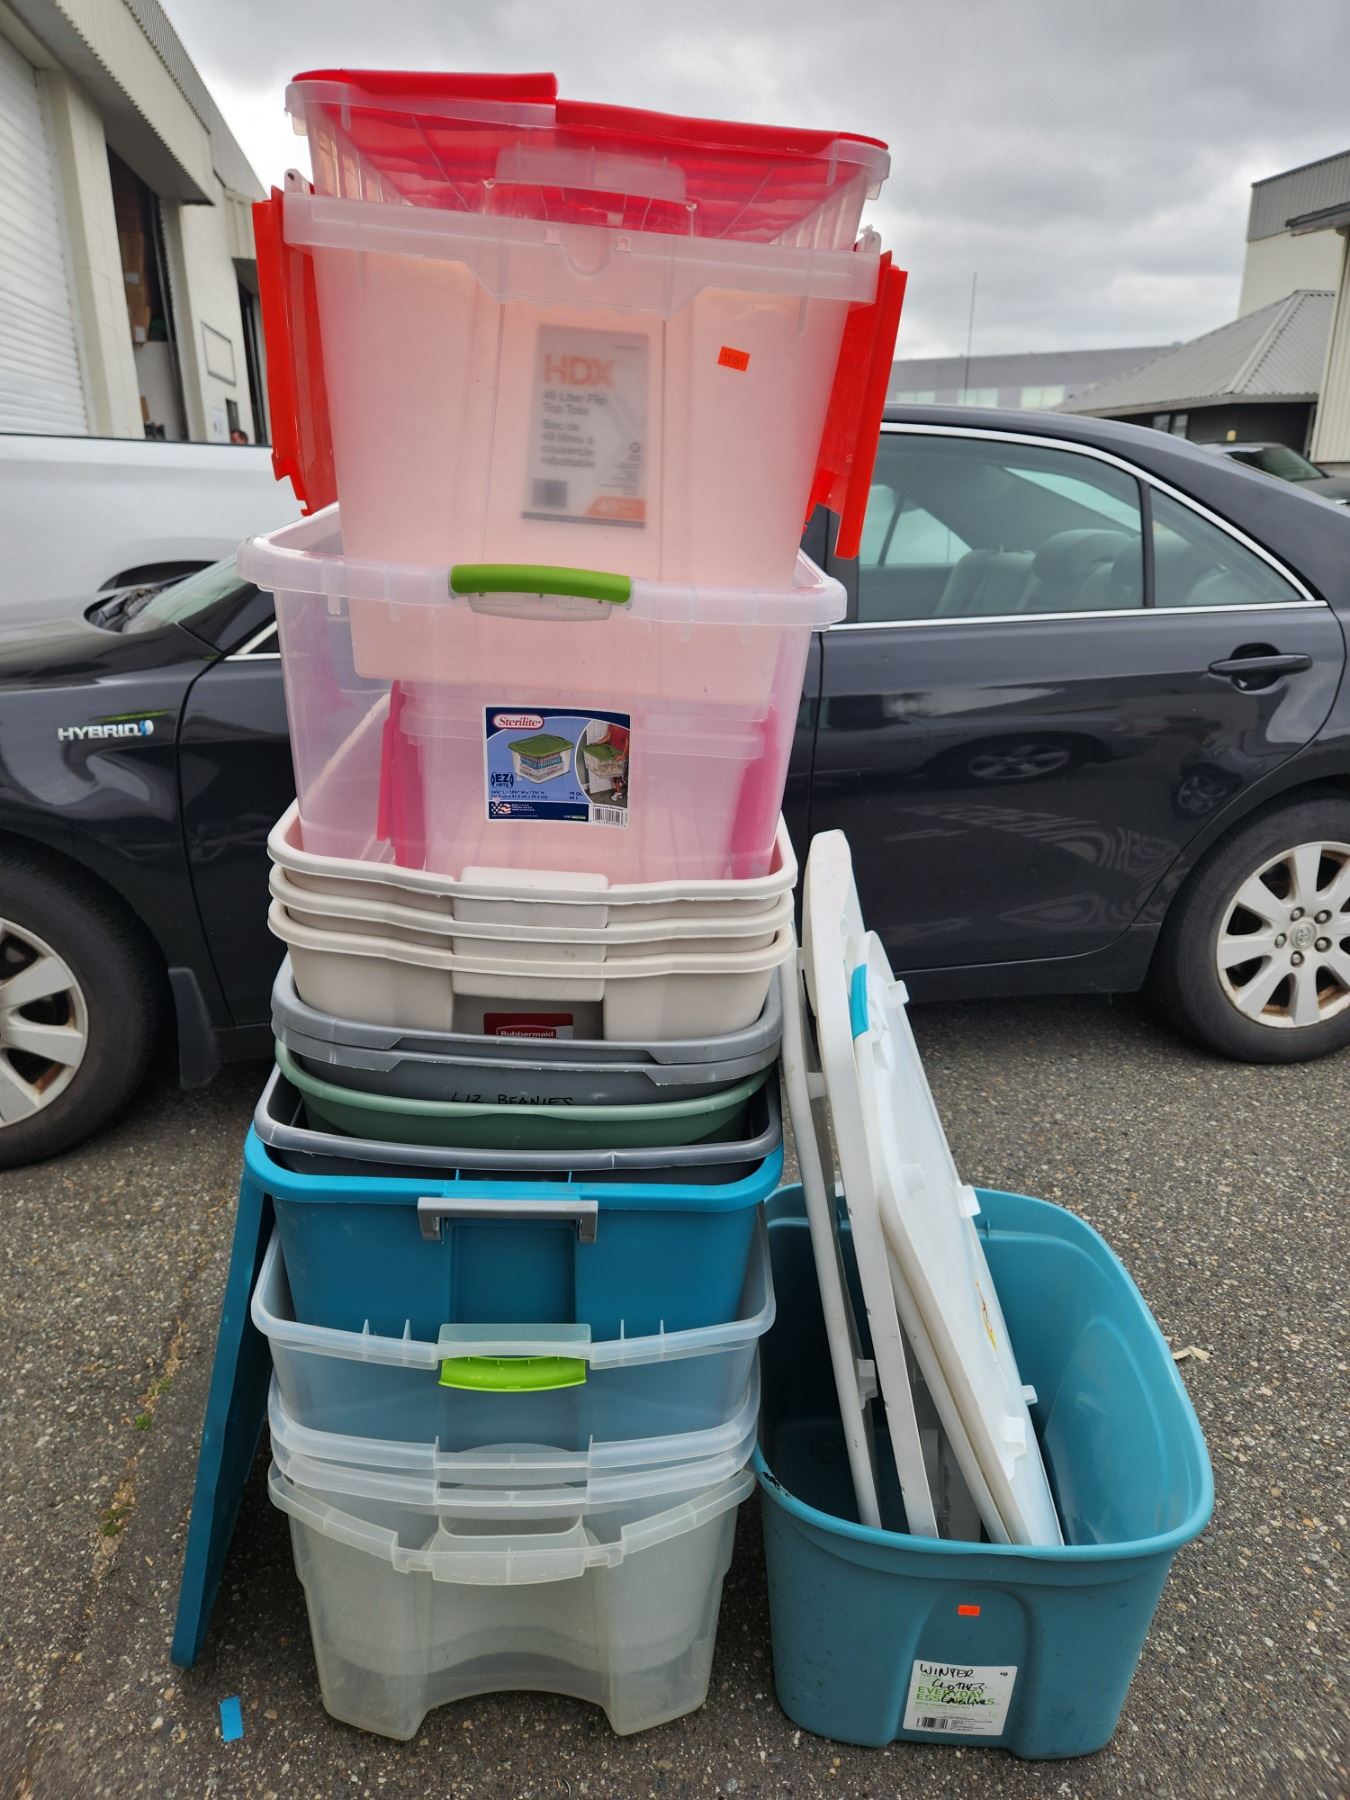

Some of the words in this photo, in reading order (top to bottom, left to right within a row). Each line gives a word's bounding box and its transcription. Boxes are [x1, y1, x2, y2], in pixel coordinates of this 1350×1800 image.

[543, 353, 616, 388] HDX
[499, 716, 536, 727] Sterilite
[57, 722, 142, 741] HYBRID
[495, 773, 510, 783] EZ
[500, 1030, 554, 1038] Rubbermaid
[451, 1091, 483, 1103] LIZ
[497, 1093, 574, 1105] BEANIES
[920, 1663, 974, 1678] WINTER
